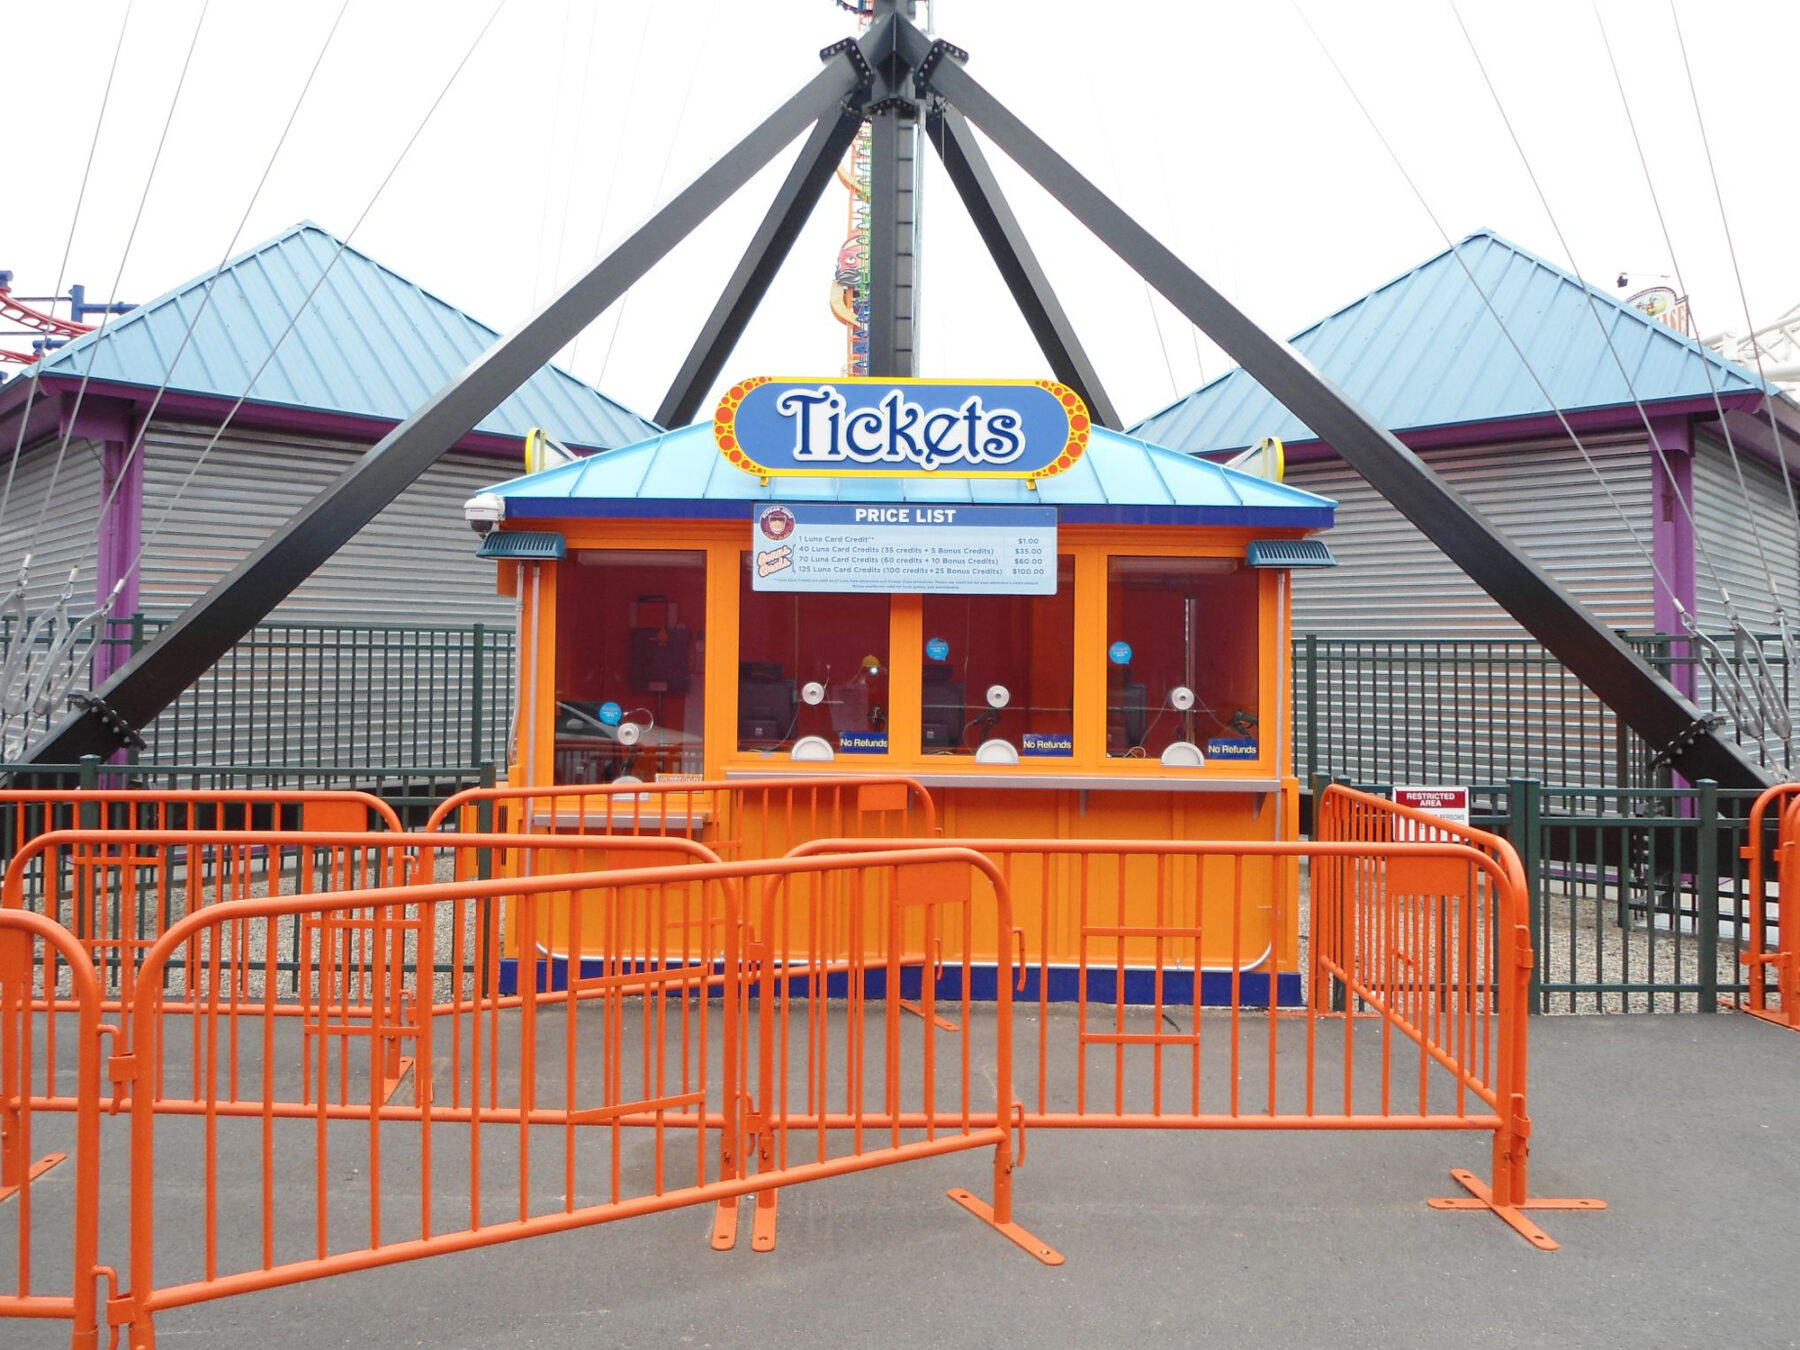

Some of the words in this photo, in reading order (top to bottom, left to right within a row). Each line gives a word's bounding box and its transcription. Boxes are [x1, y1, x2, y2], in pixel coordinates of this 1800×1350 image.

[780, 387, 1024, 467] Tickets
[855, 509, 909, 523] PRICE
[916, 509, 957, 523] LIST
[840, 737, 852, 747] No
[853, 737, 888, 748] Refunds
[1023, 739, 1035, 749] No
[1036, 739, 1072, 749] Refunds
[1208, 745, 1220, 753] No
[1222, 745, 1257, 754] Refunds
